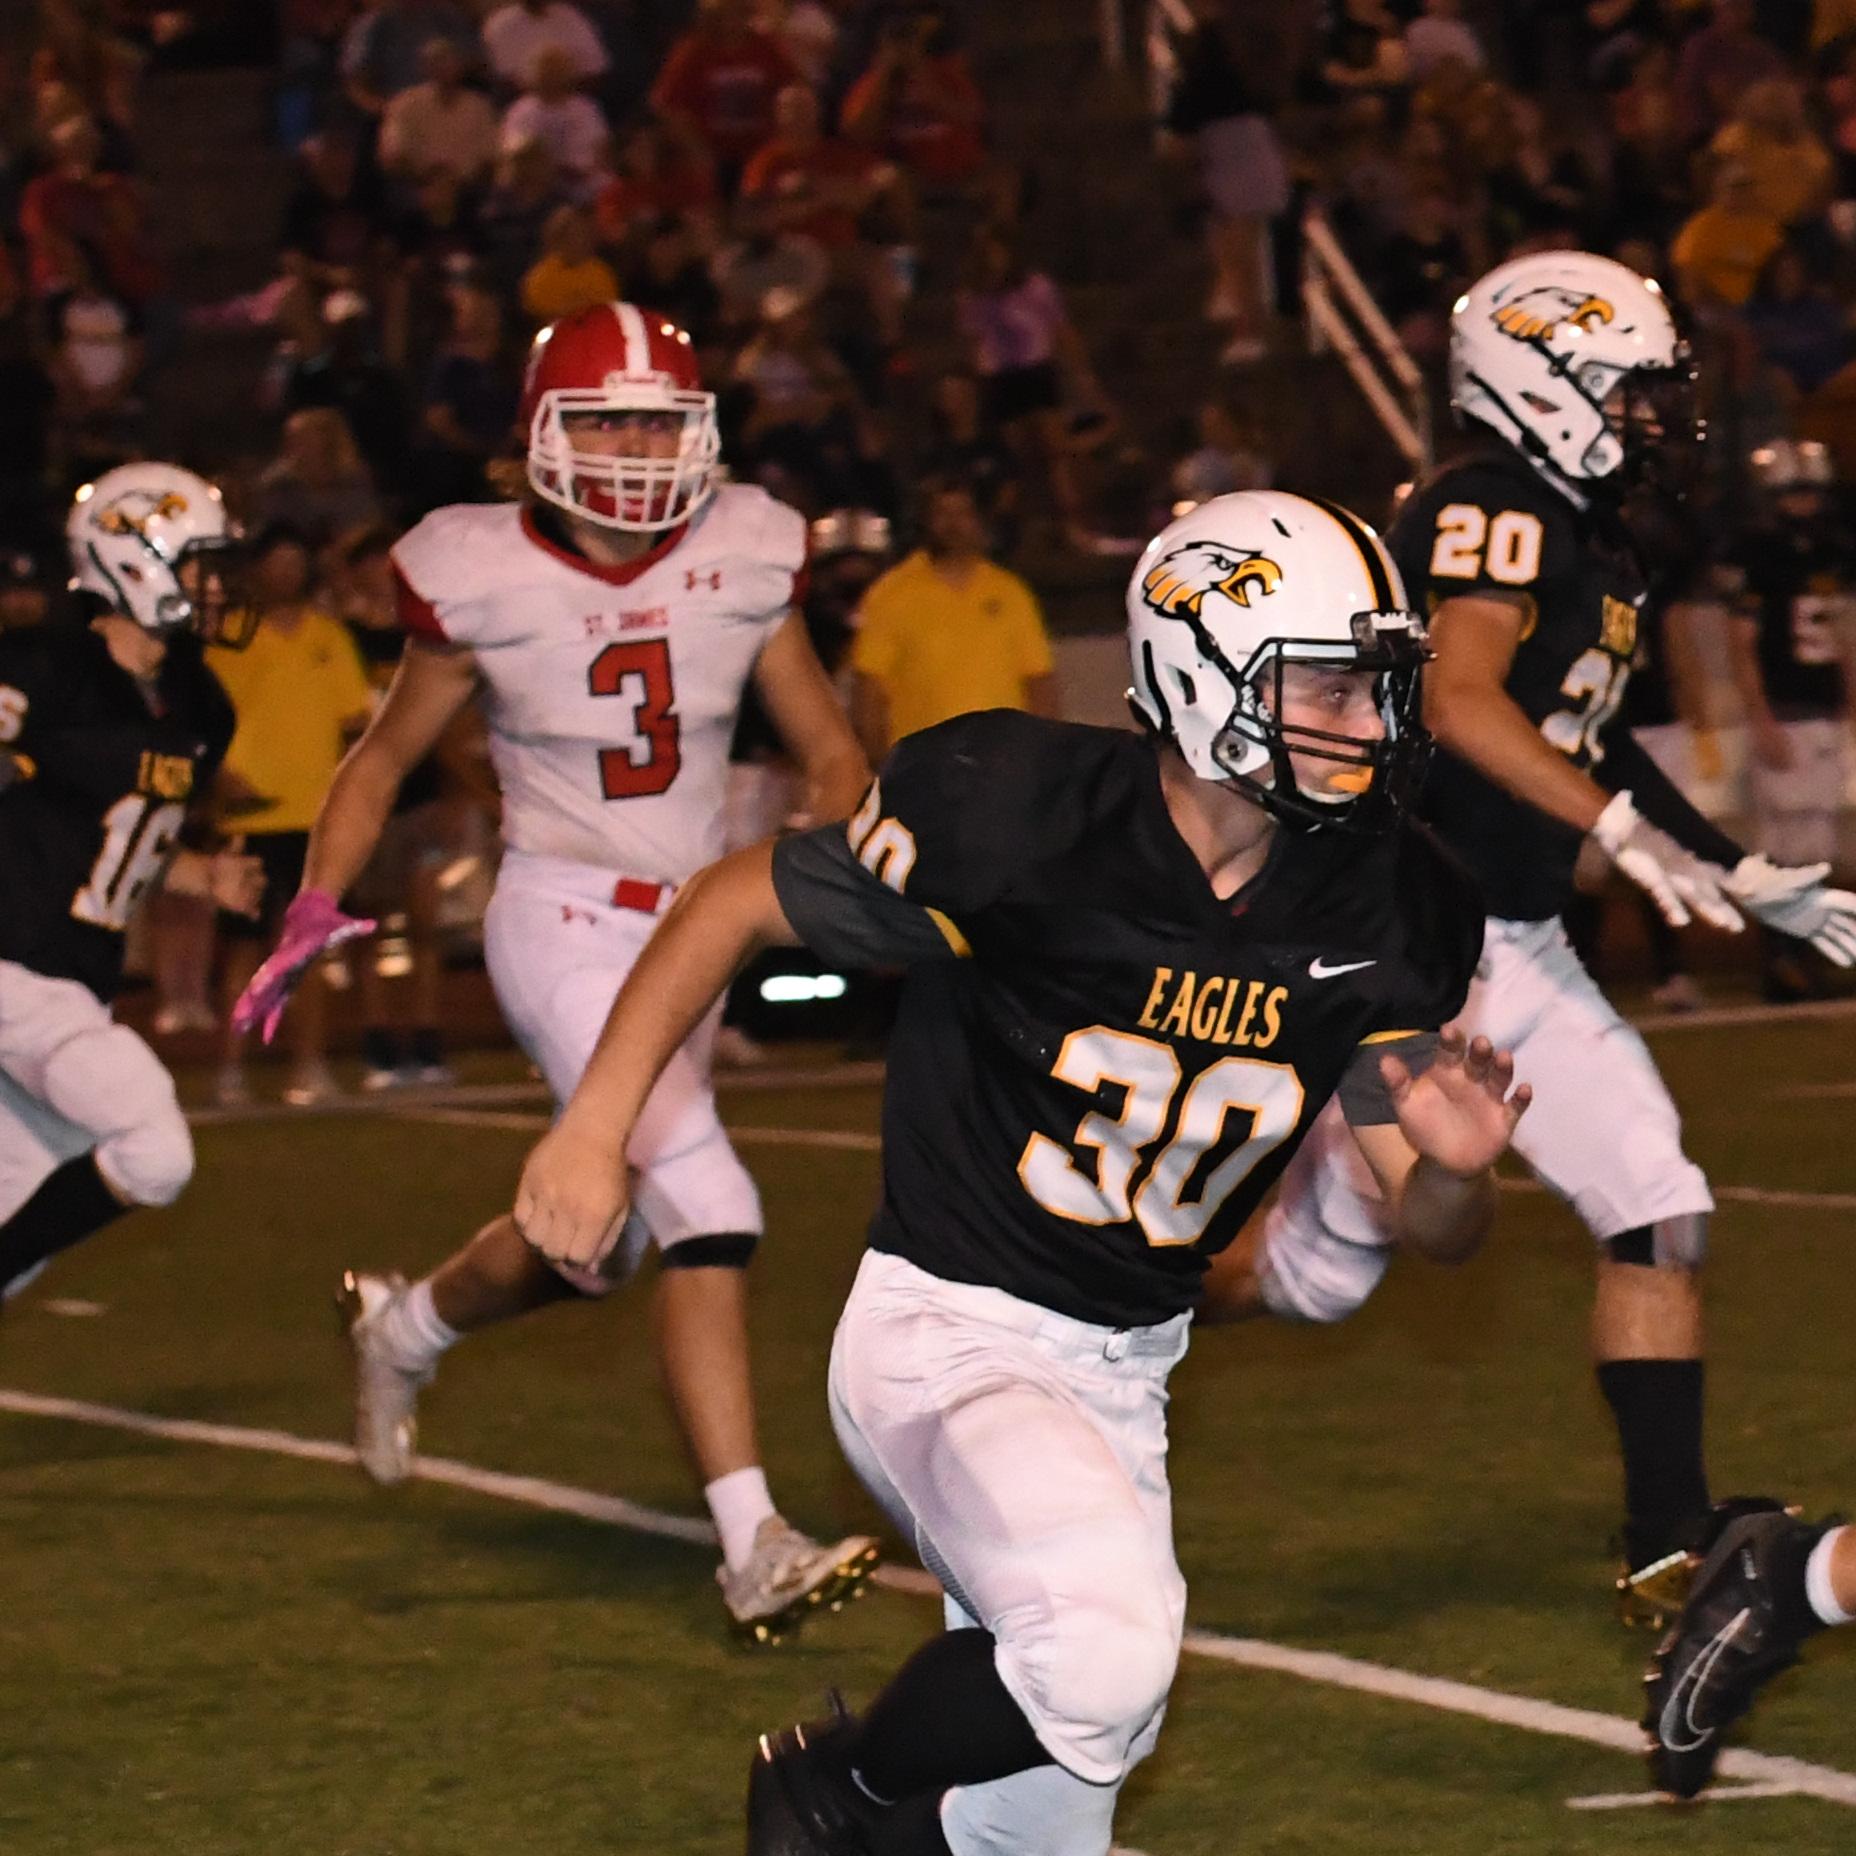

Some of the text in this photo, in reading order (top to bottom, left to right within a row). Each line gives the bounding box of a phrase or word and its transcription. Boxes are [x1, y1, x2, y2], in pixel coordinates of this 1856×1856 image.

[1428, 503, 1544, 585] 20
[587, 636, 681, 800] 3
[1137, 966, 1289, 1048] EAGLES
[1016, 1024, 1305, 1248] 30
